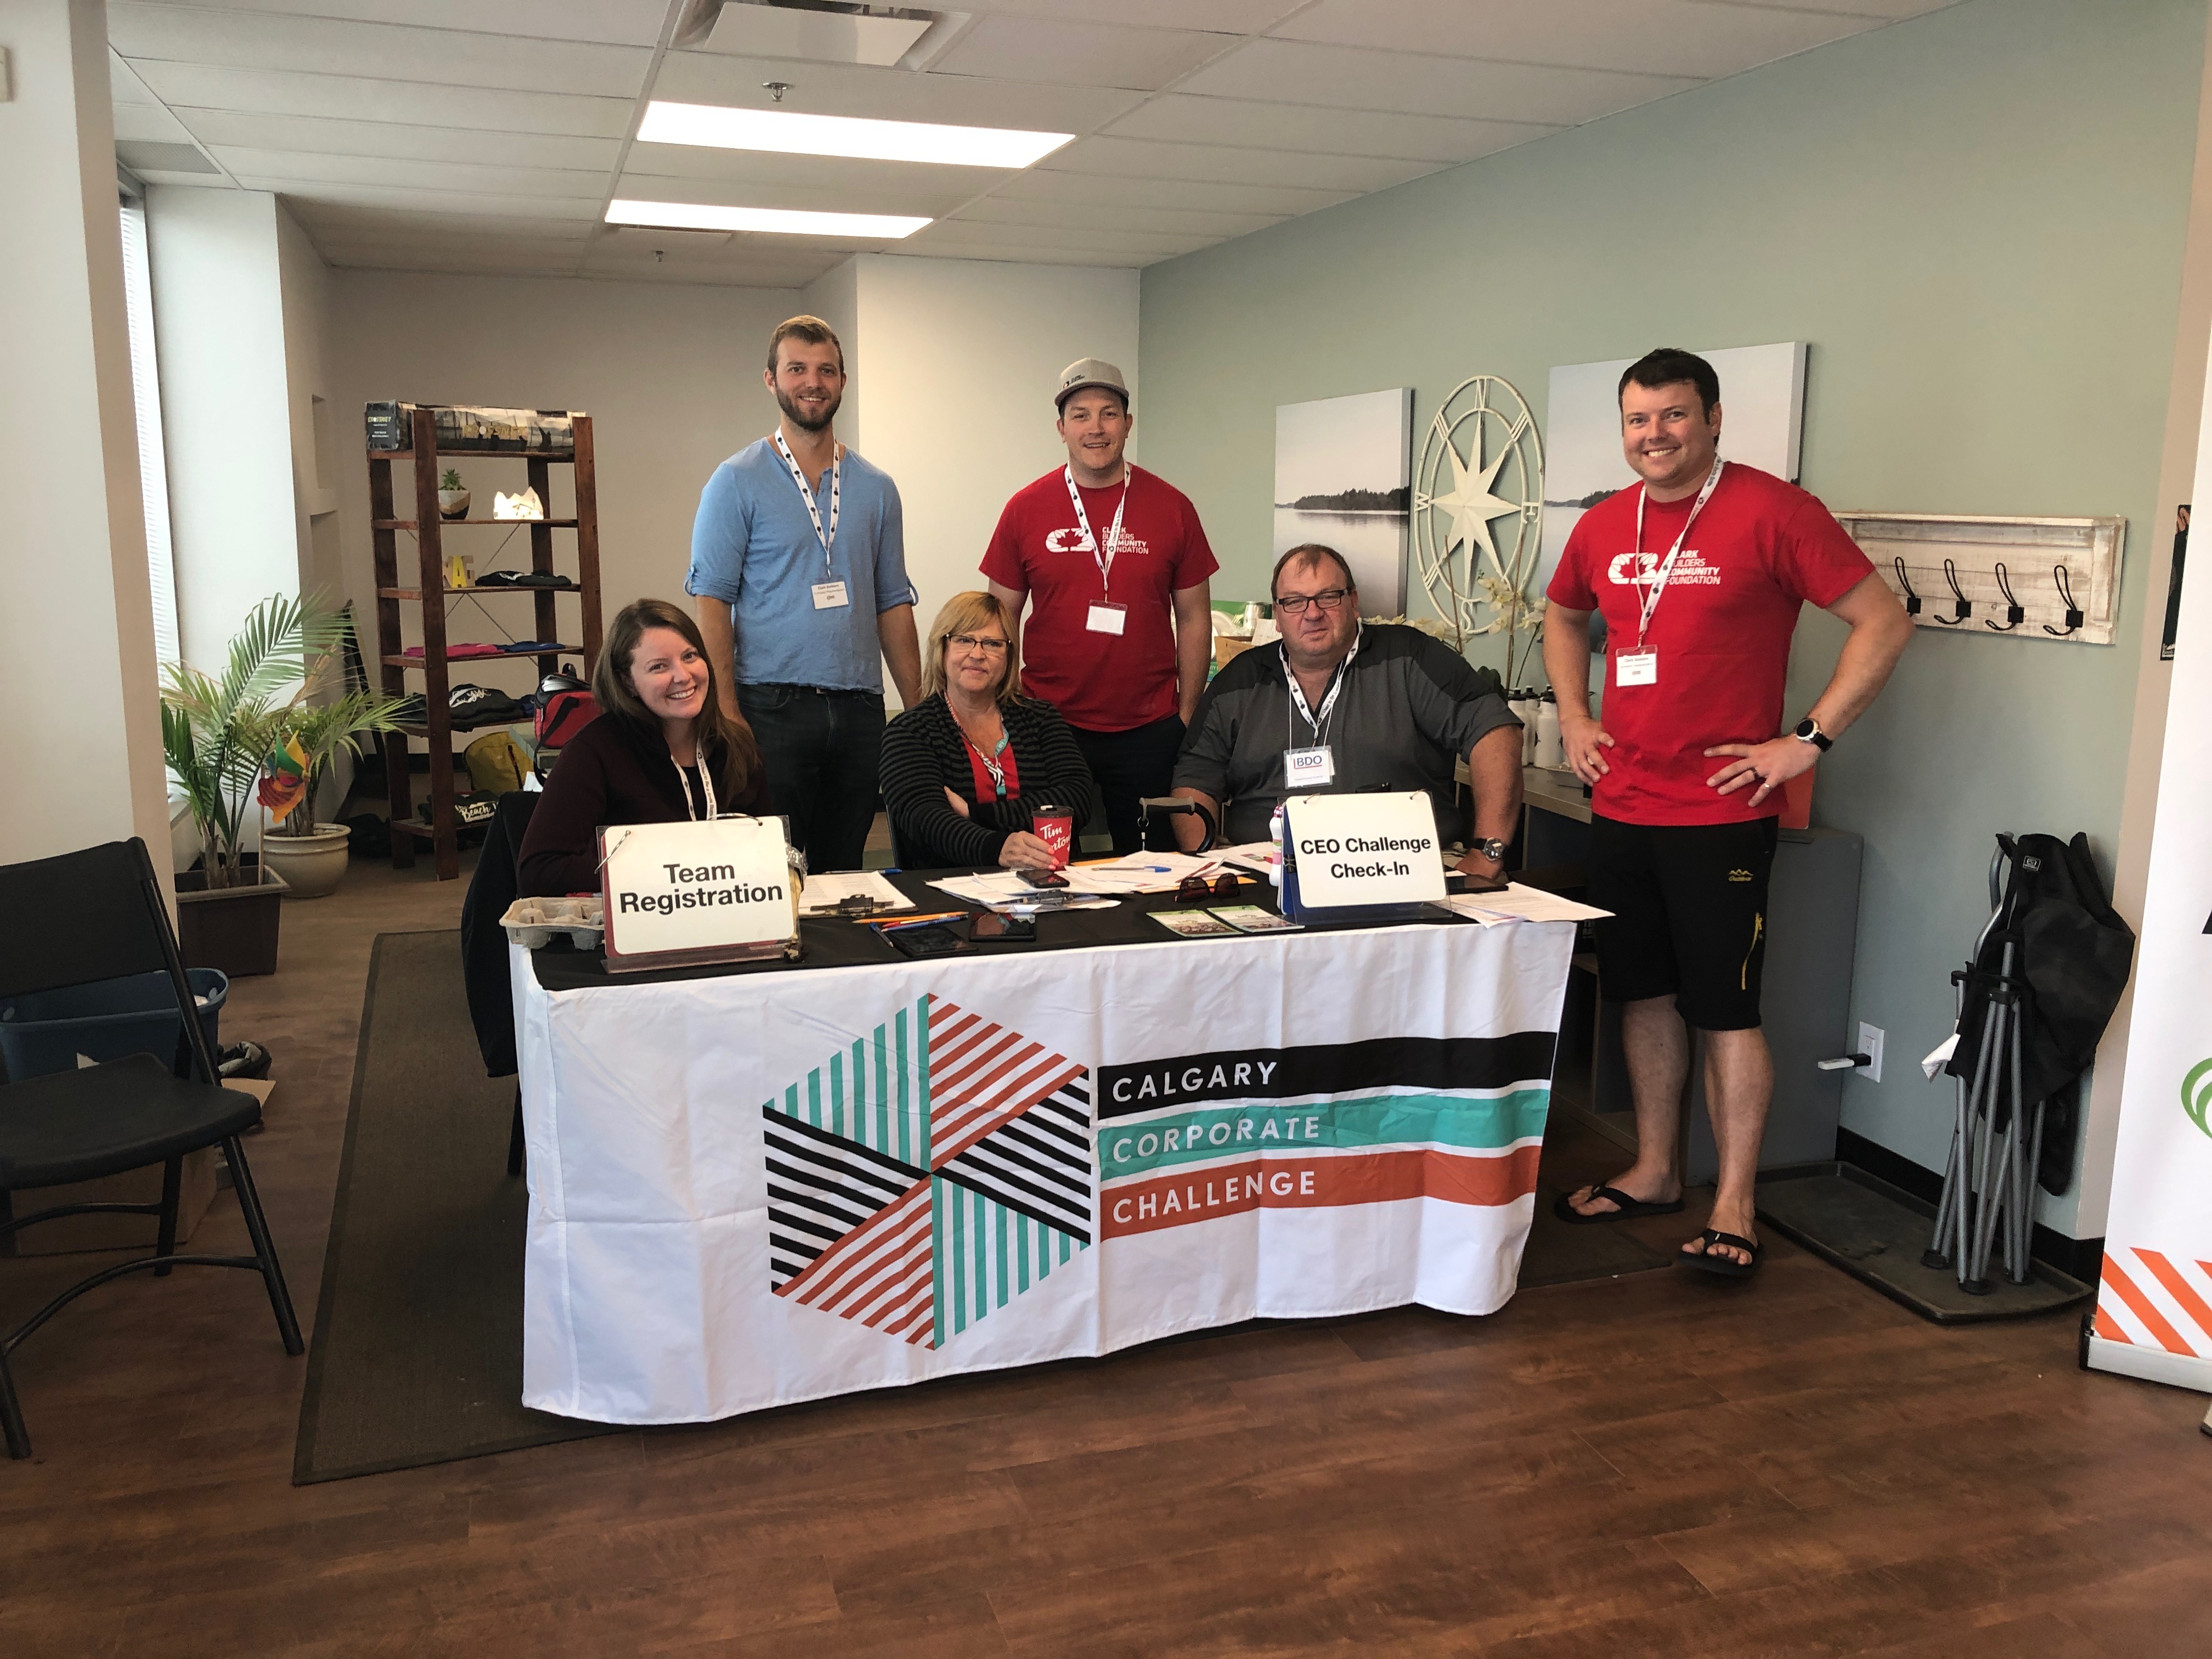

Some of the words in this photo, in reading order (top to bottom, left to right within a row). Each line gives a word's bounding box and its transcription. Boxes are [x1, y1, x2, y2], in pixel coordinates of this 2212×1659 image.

[1102, 546, 1149, 555] FNDATION
[1676, 550, 1699, 558] ARK
[1668, 567, 1720, 576] OMMUNITY
[1296, 755, 1322, 767] BDO
[1040, 823, 1063, 839] Tim
[1301, 839, 1340, 855] CEO
[1346, 836, 1431, 854] Challenge
[663, 864, 735, 884] Team
[1331, 861, 1409, 878] Check-In
[619, 884, 783, 914] Registration
[1113, 1062, 1277, 1102] CALGARY
[1113, 1116, 1319, 1163] CORPORATE
[1113, 1171, 1314, 1223] CHALLENGE
